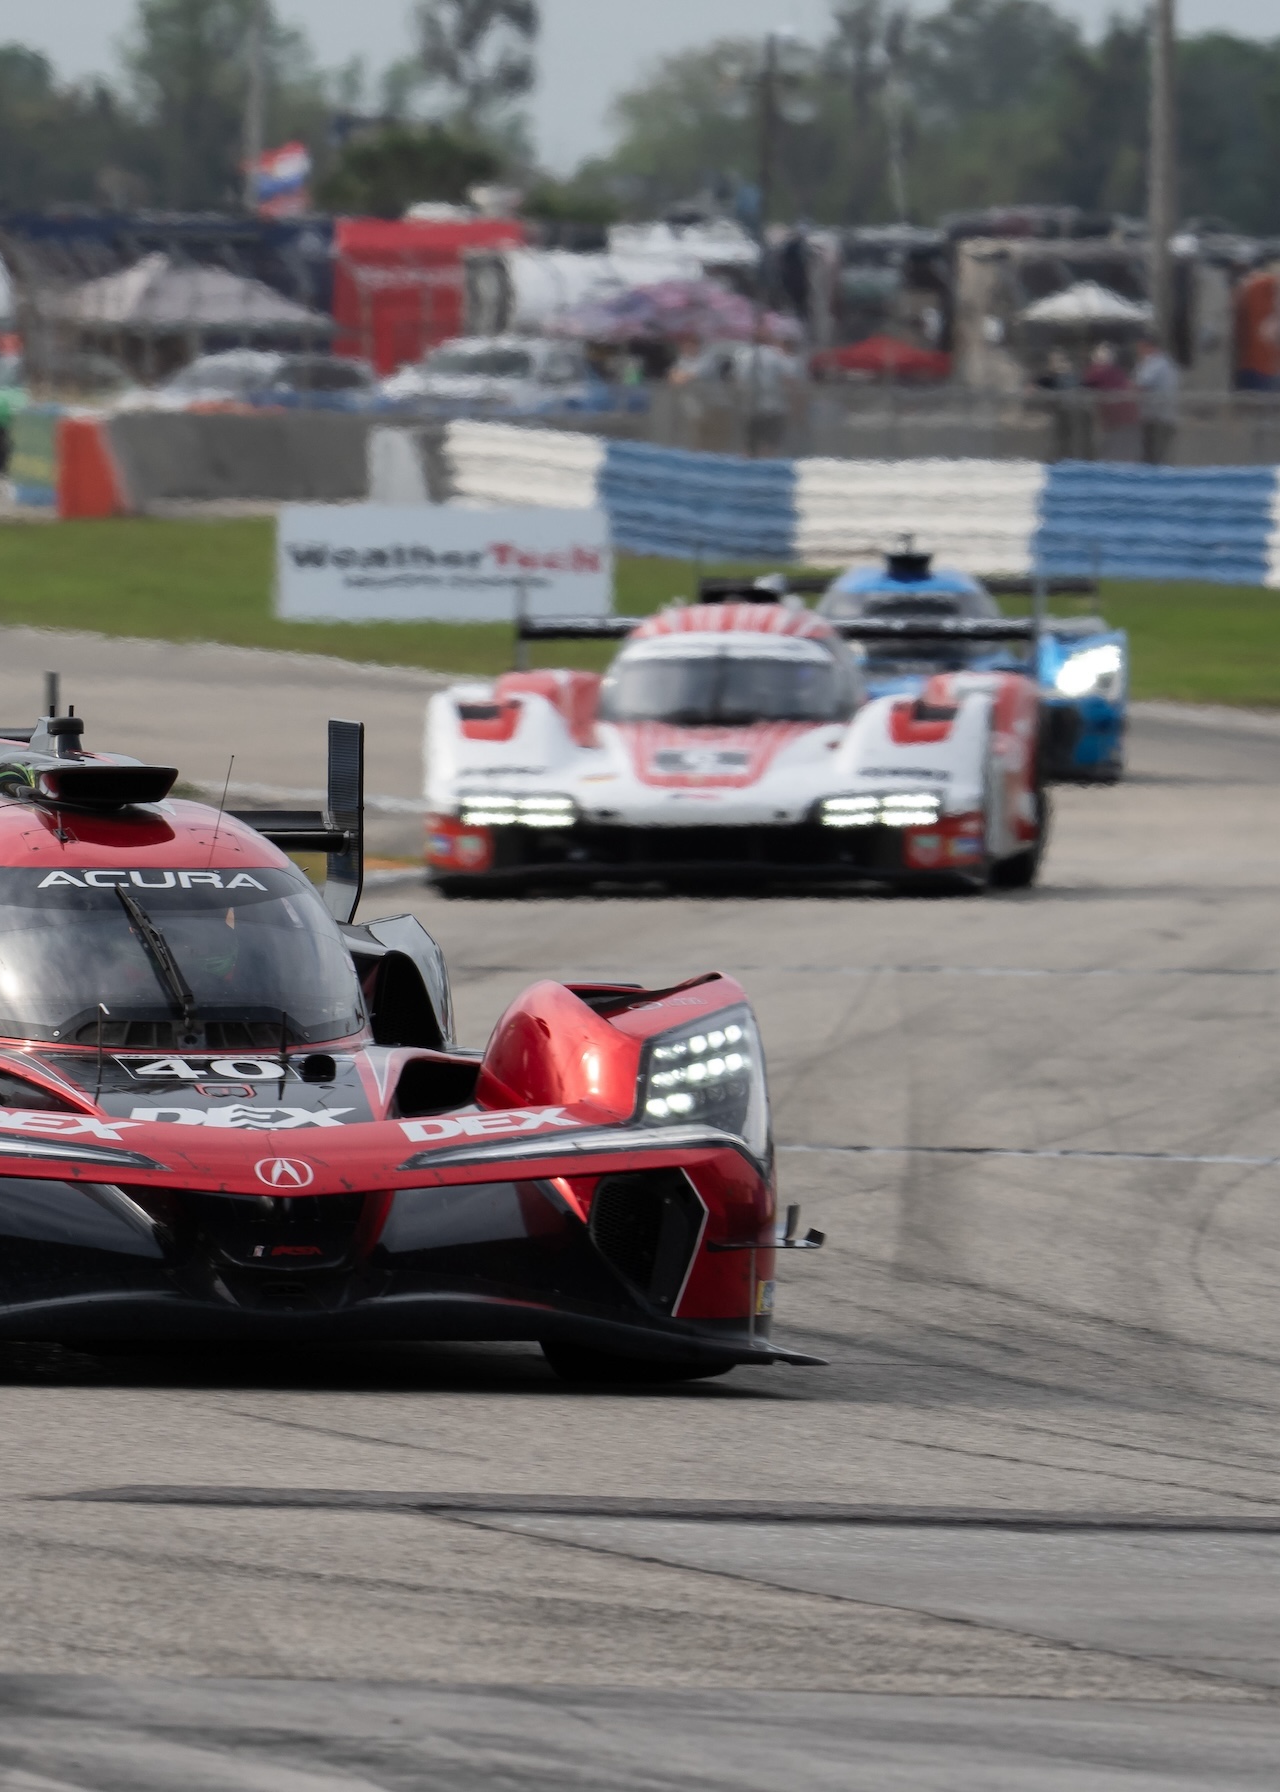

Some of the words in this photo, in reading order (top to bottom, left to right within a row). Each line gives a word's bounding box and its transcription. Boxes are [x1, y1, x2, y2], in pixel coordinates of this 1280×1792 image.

[286, 542, 601, 573] WeatherTech
[37, 869, 269, 892] ACURA
[135, 1058, 286, 1080] 40
[130, 1103, 358, 1130] DEX
[398, 1106, 583, 1143] DEX
